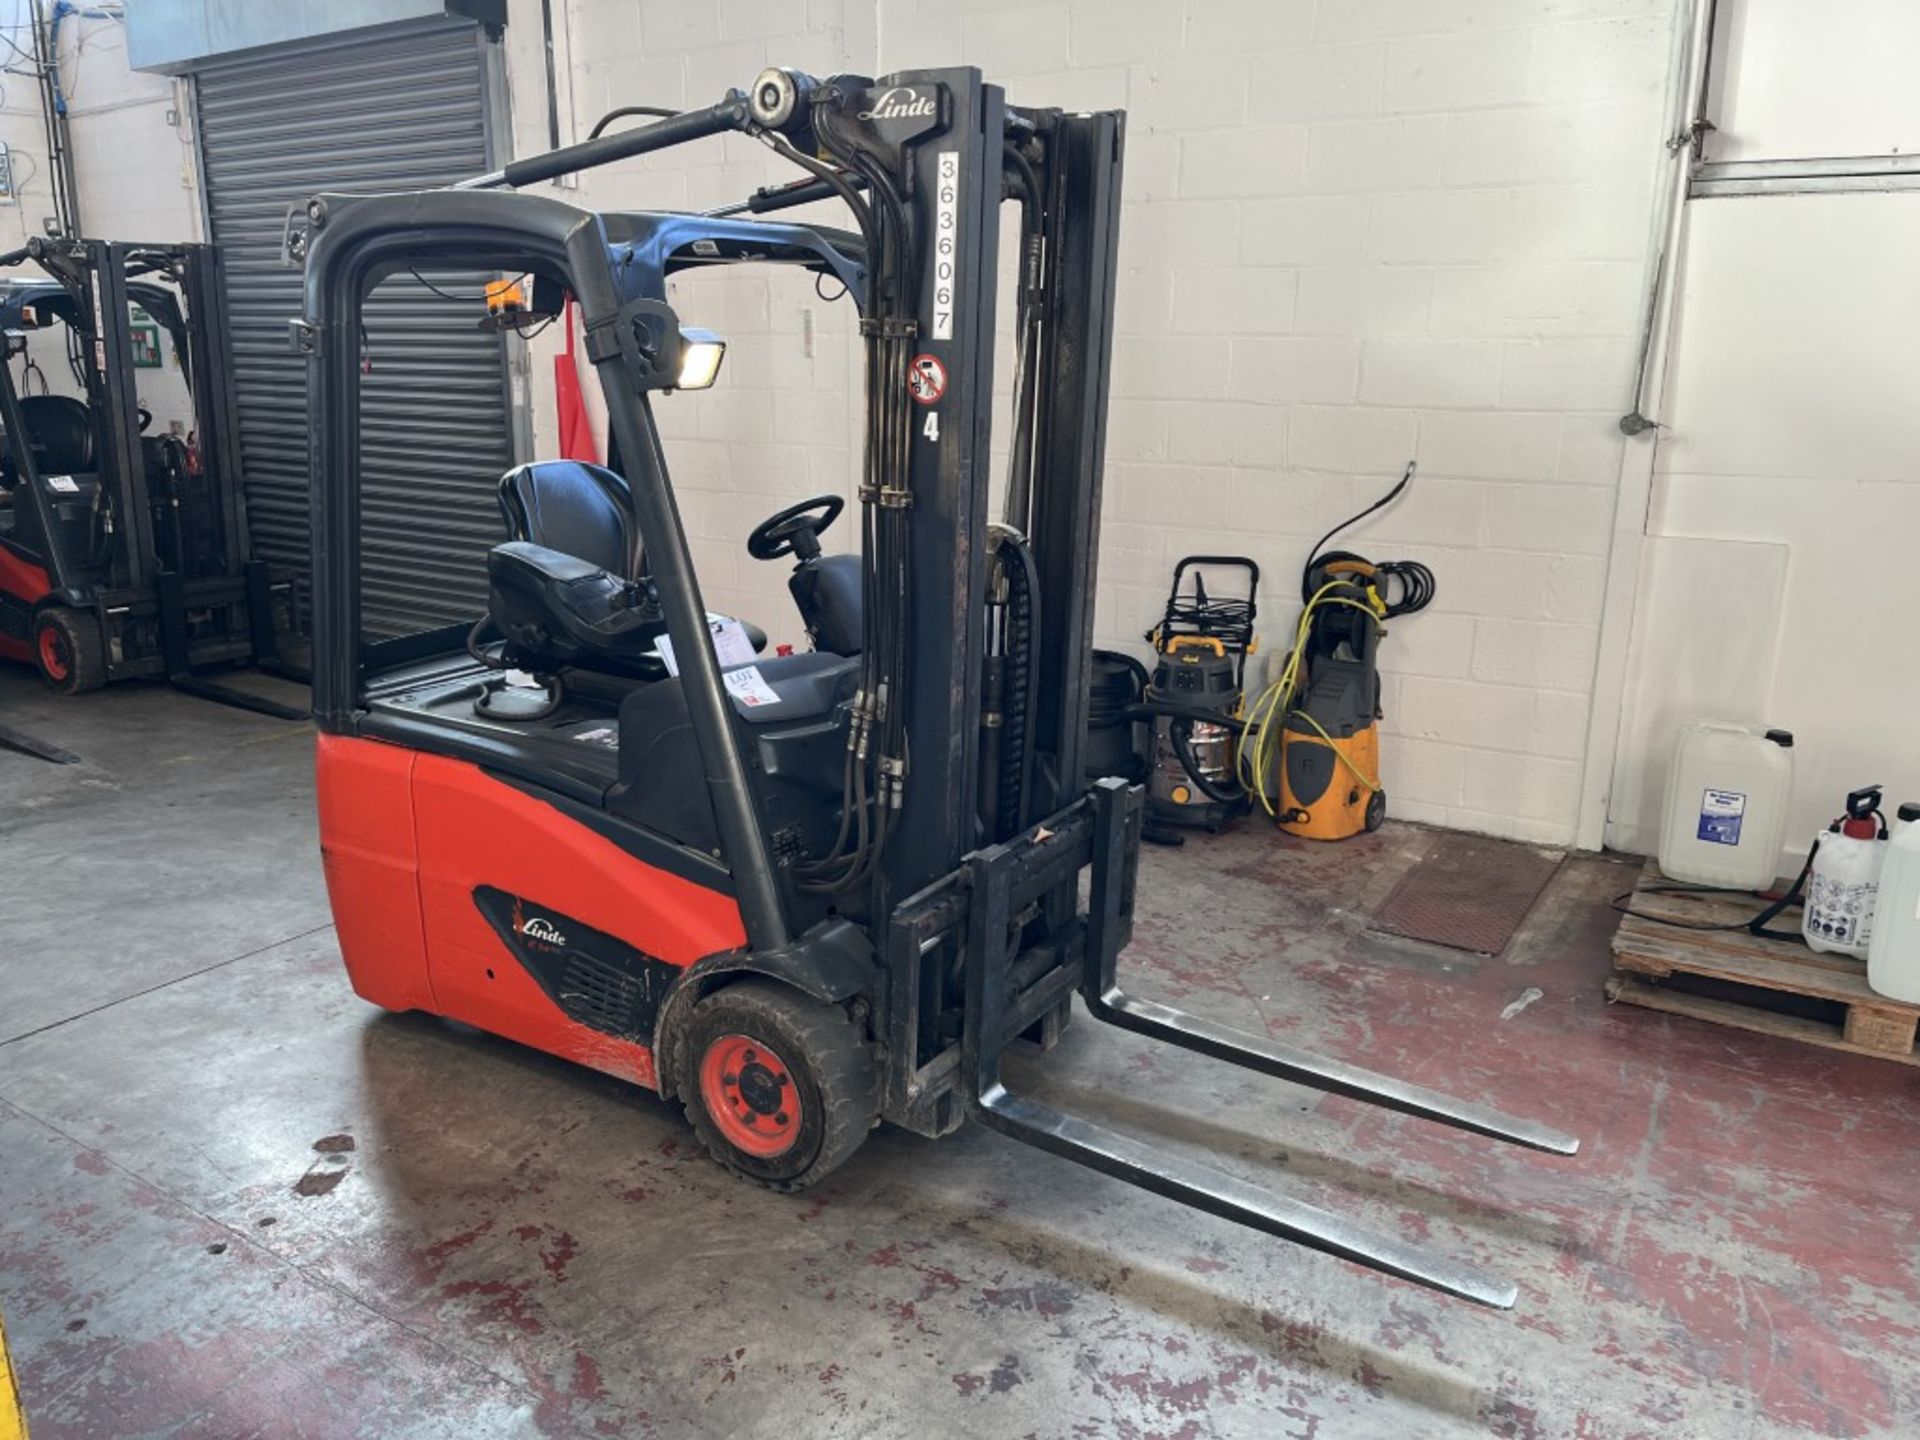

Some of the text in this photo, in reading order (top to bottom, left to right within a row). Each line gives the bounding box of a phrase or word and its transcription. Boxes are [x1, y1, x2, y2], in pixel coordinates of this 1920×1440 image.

[857, 87, 936, 121] Linde
[937, 160, 955, 329] 3636067
[923, 411, 940, 442] 4
[514, 917, 566, 946] Linde
